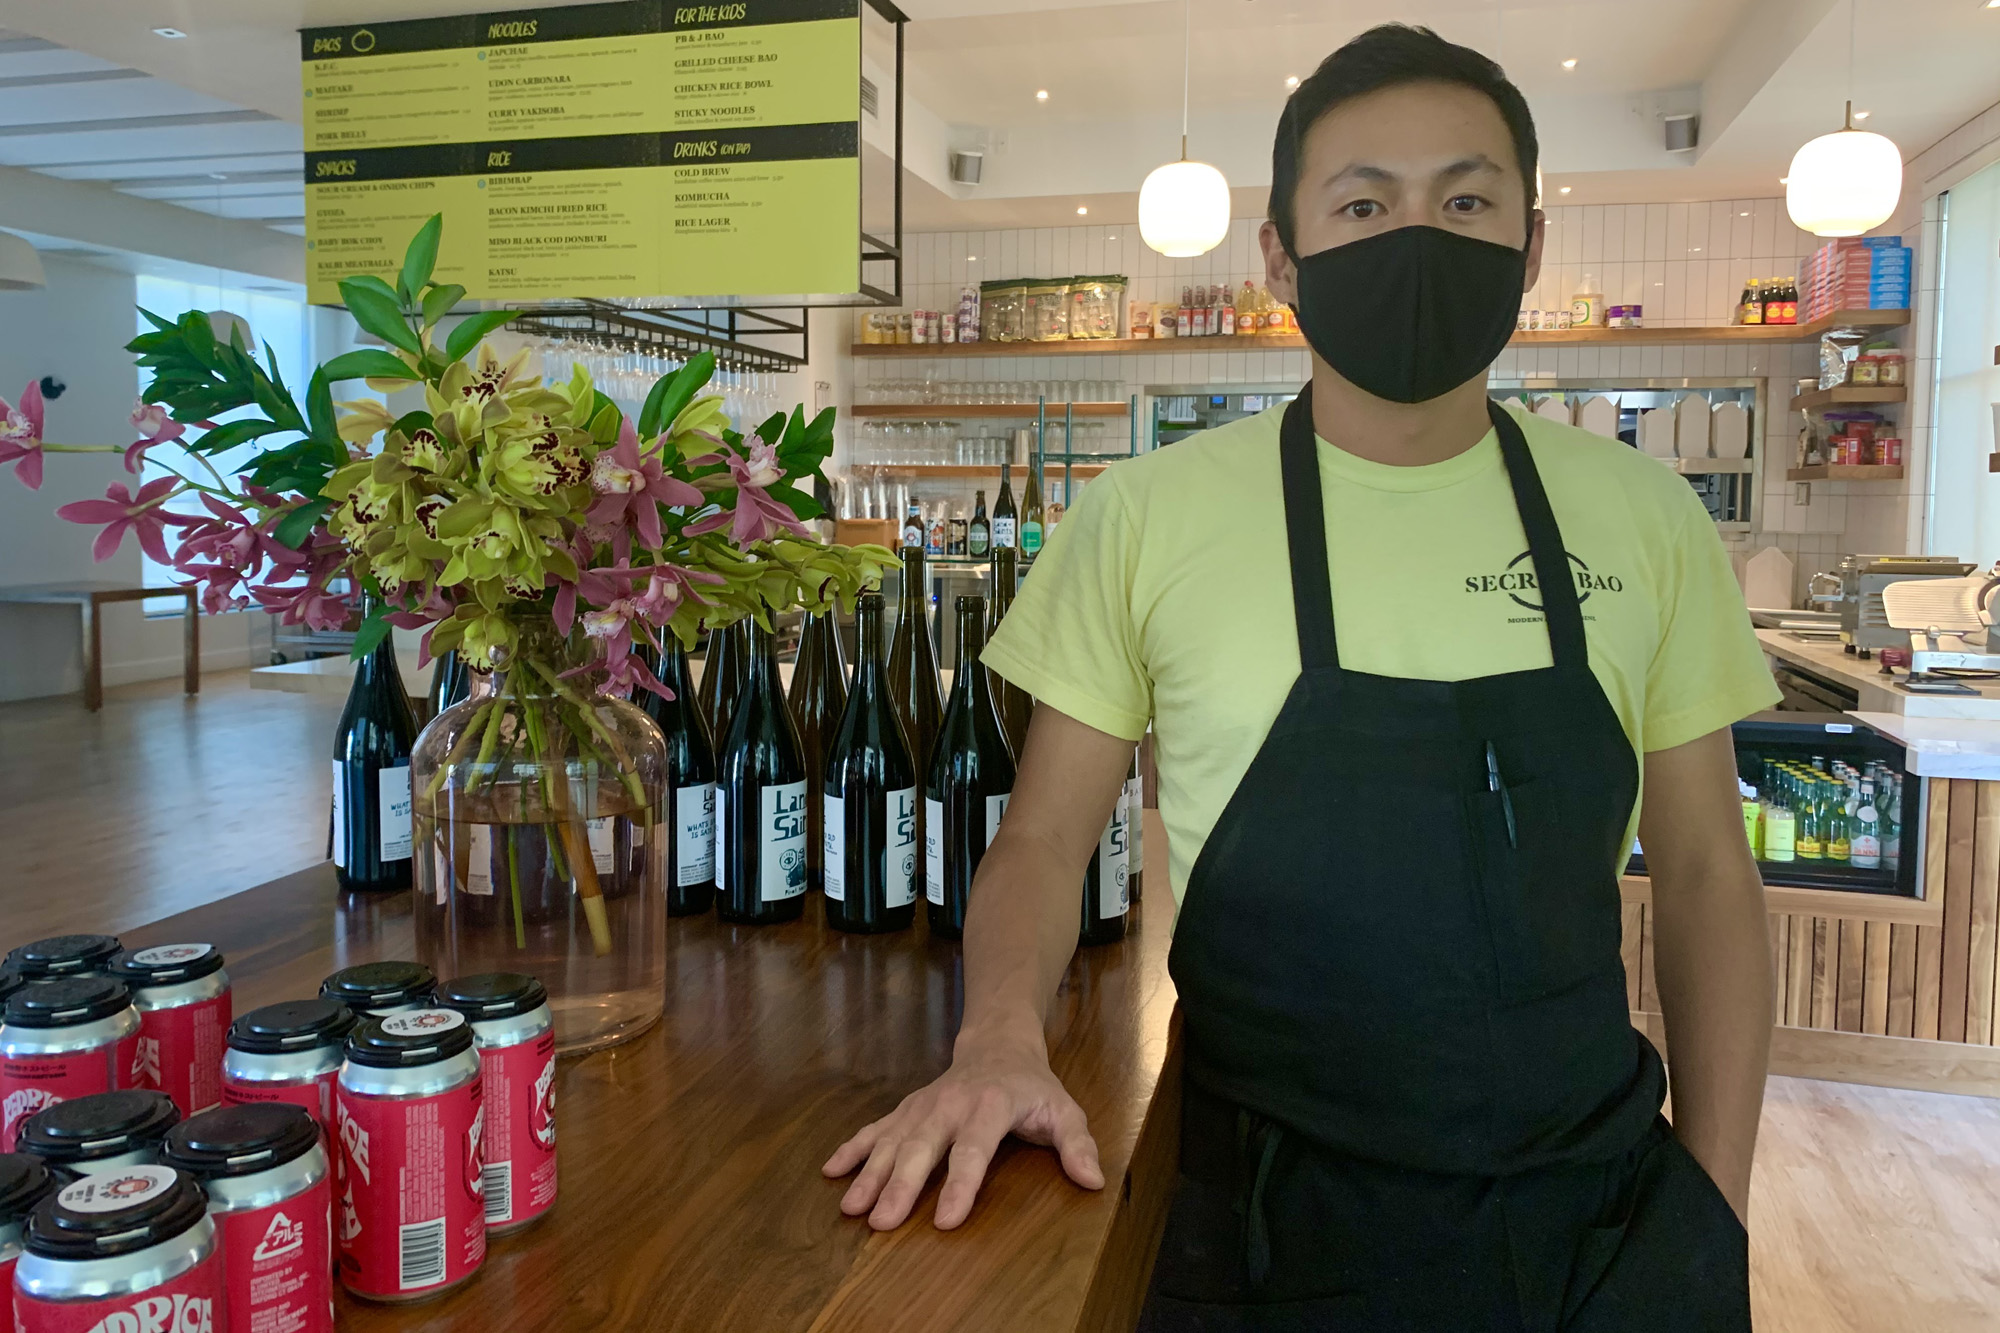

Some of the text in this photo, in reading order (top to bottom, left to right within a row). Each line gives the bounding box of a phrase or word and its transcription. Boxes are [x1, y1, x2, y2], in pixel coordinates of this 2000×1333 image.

[674, 4, 747, 24] FOR THE KIDS
[488, 20, 538, 38] NOODLES
[675, 32, 725, 44] PB & J BAO
[488, 48, 528, 57] JAPCHAE
[674, 53, 778, 68] GRILLED CHEESE BAO
[488, 75, 572, 88] UDON CARBONARA
[674, 80, 774, 94] CHICKEN RICE BOWL
[488, 106, 565, 118] CURRY YAKISOBA
[674, 106, 756, 118] STICKY NOODLES
[673, 140, 718, 158] DRINKS
[487, 152, 512, 167] RICE
[315, 160, 357, 178] SNACKS
[674, 168, 730, 178] COLD BREW
[409, 182, 436, 190] CHIPS
[488, 176, 532, 185] BIBIMBAP
[675, 192, 730, 202] KOMBUCHA
[488, 204, 608, 215] BACON KIMCHI FRIED RICE
[675, 217, 731, 227] RICE LAGER
[488, 235, 607, 245] MISO BLACK COD DONBURI
[344, 260, 394, 268] MEATBALLS
[1465, 572, 1623, 593] SECR BAO
[1508, 616, 1544, 624] MODERN
[773, 790, 806, 814] Lan
